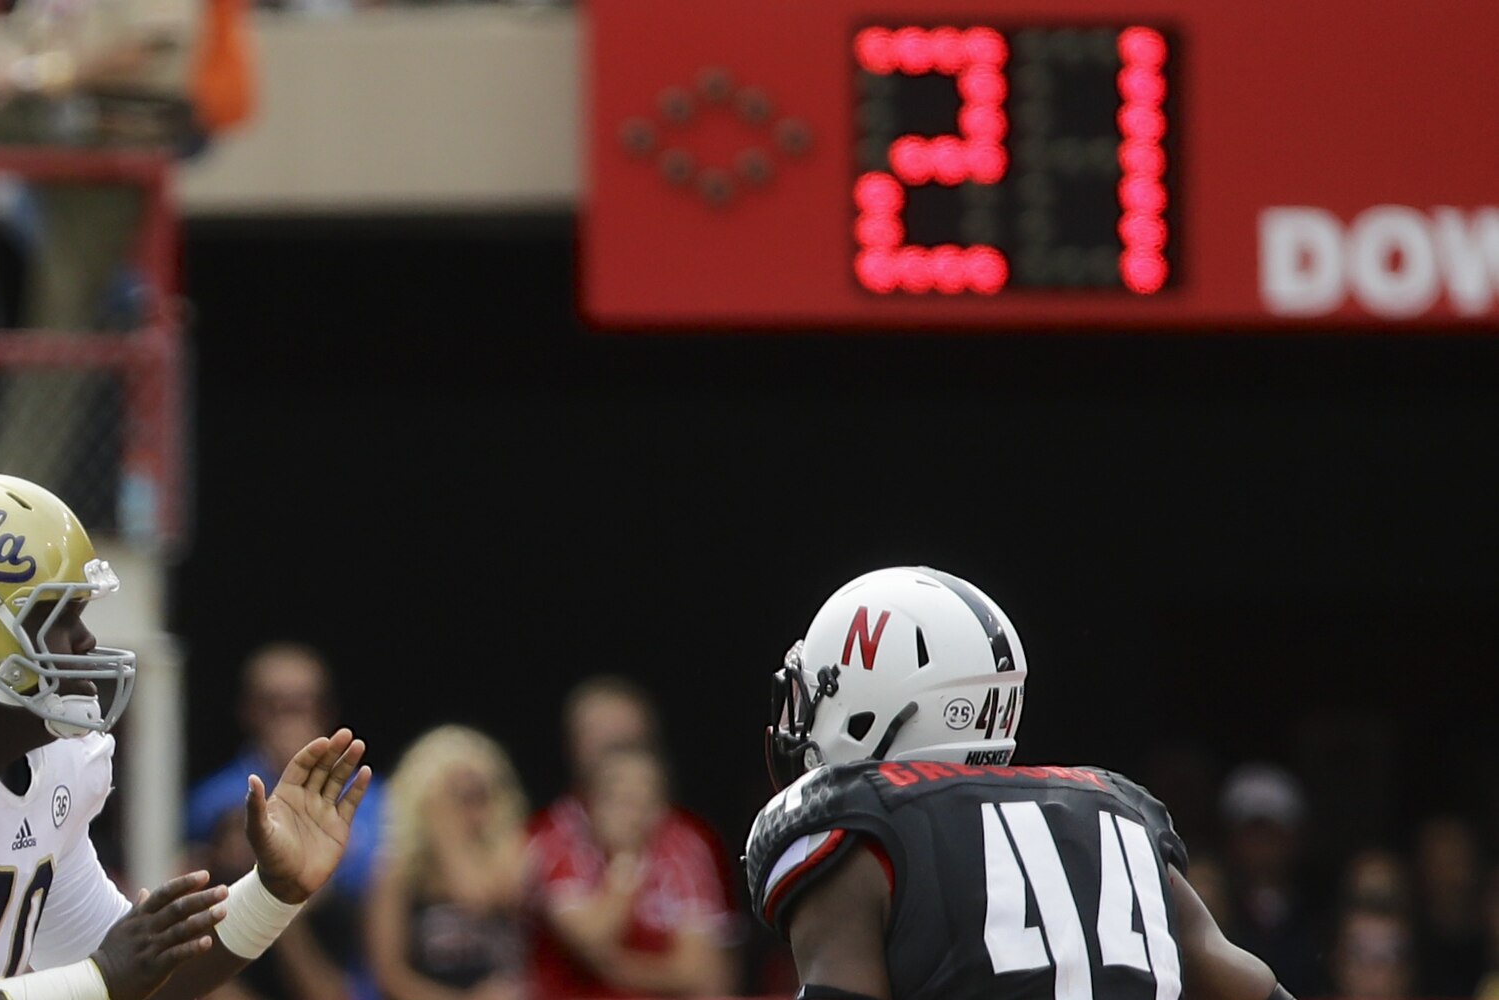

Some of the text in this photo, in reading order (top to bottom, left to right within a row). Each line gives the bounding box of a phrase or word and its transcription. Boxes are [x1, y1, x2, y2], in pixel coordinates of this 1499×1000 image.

[855, 25, 1168, 294] 21
[841, 606, 891, 671] N
[975, 687, 1017, 740] 44
[55, 795, 68, 817] 36
